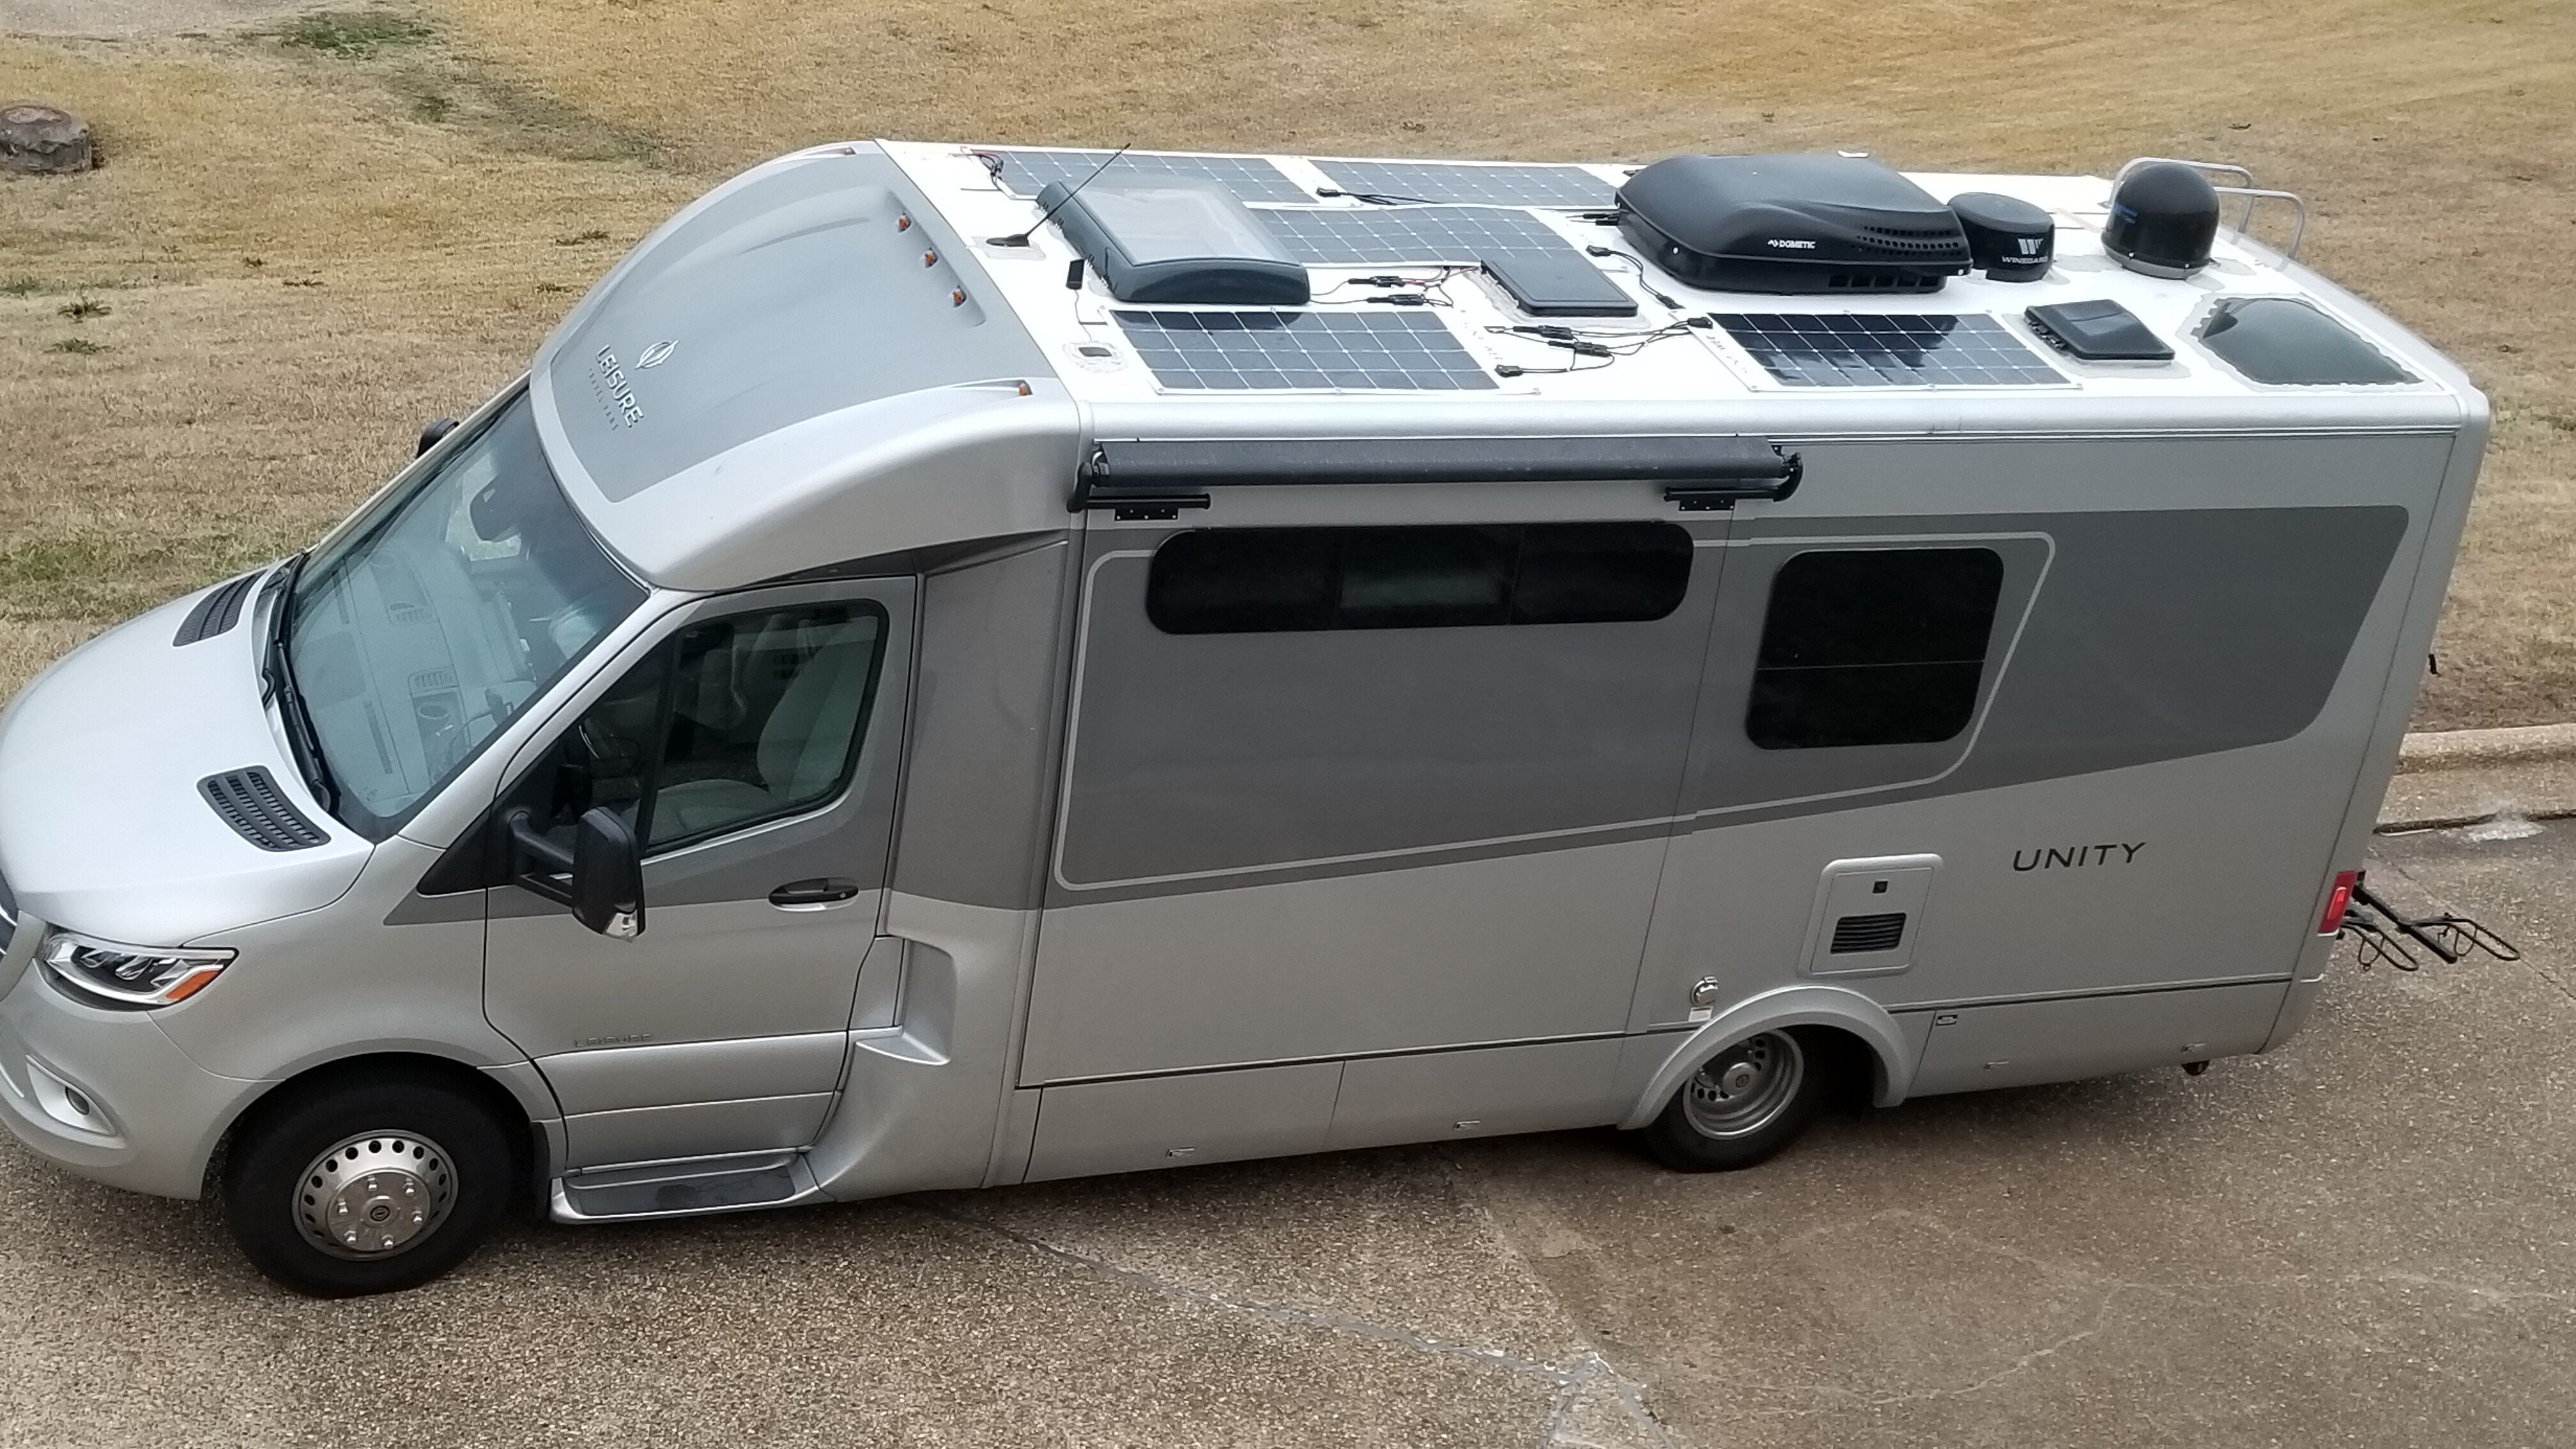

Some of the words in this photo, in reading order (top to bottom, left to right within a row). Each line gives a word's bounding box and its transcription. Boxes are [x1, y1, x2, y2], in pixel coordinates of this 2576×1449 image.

[1779, 240, 1816, 249] DOMETIC
[596, 344, 644, 428] LEISURE
[2013, 841, 2146, 871] UNITY
